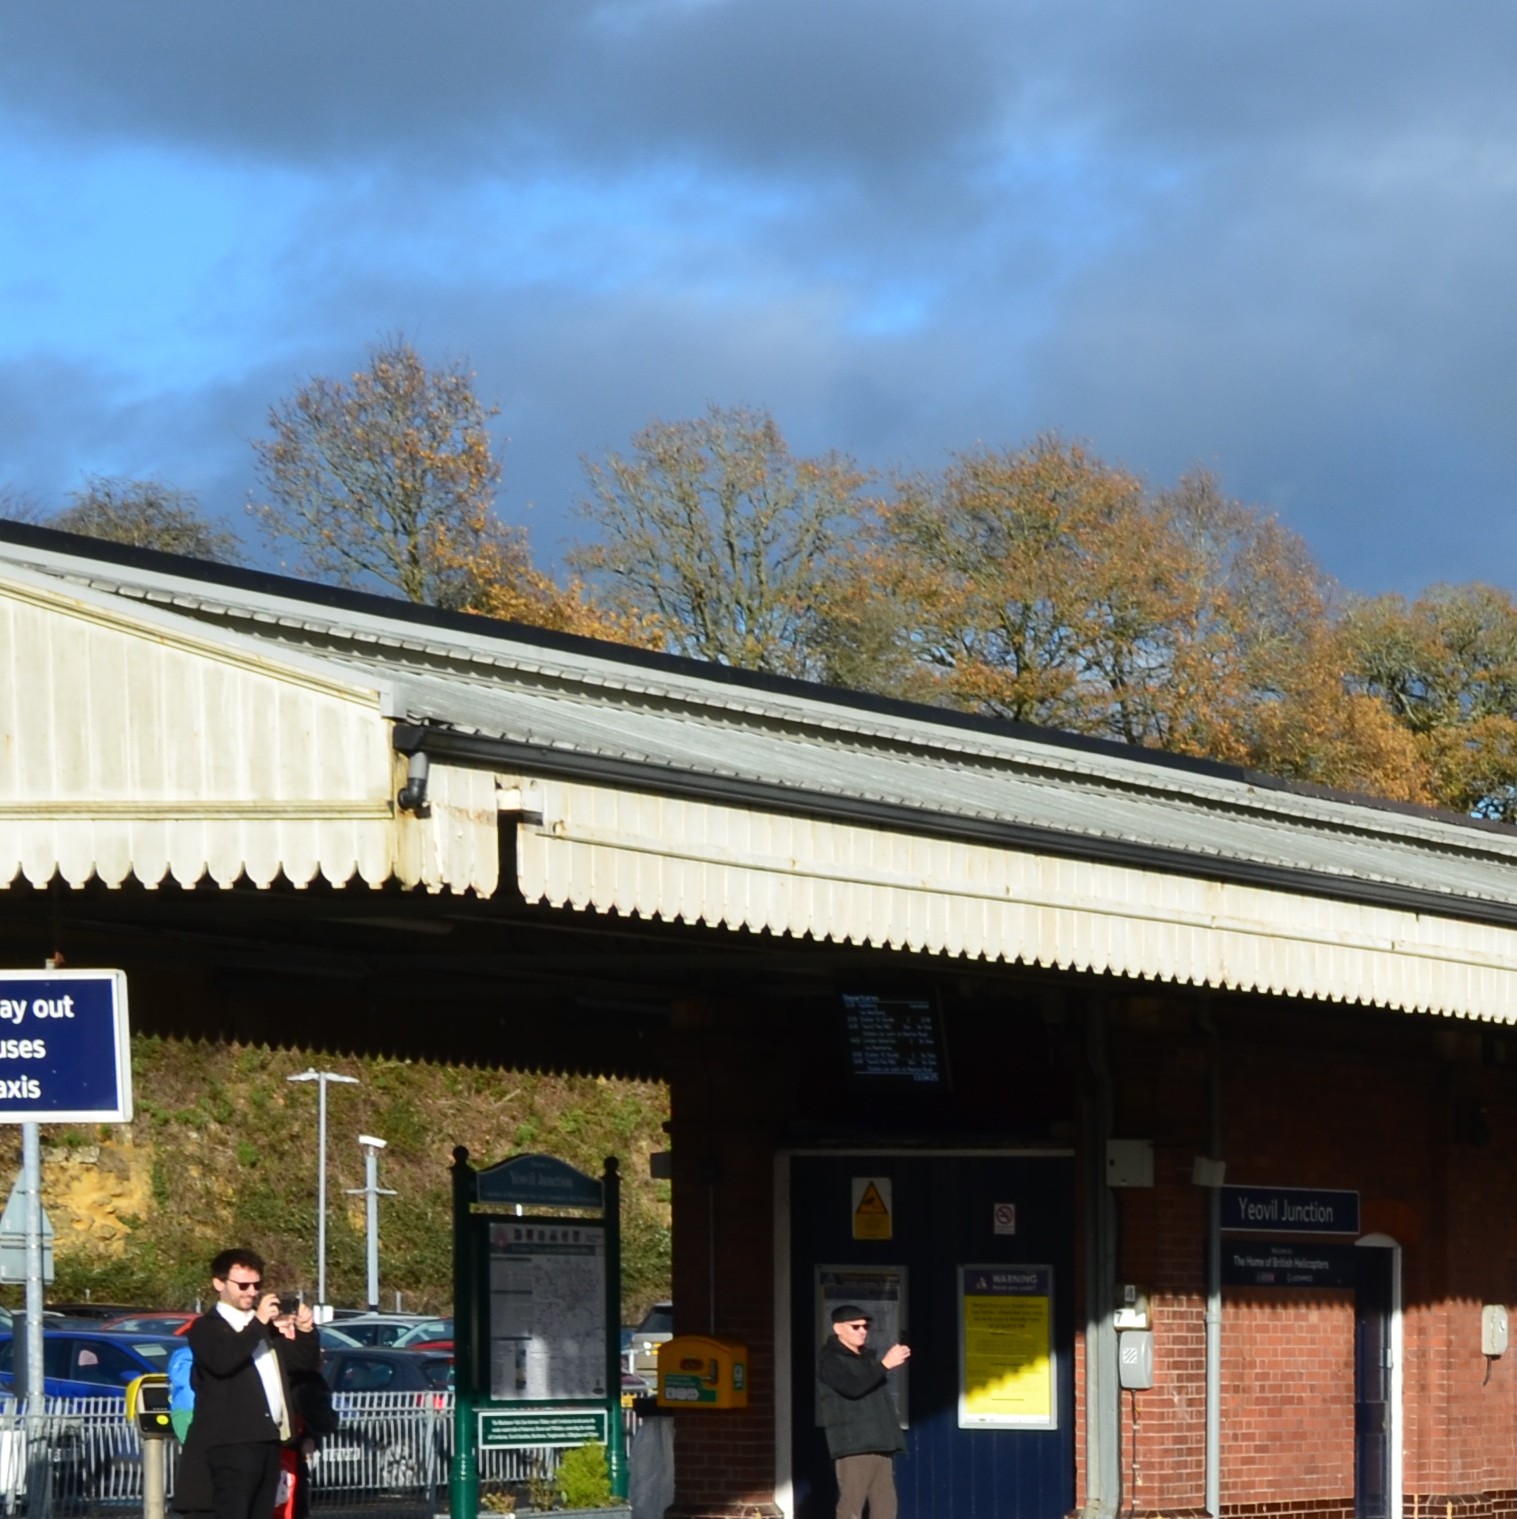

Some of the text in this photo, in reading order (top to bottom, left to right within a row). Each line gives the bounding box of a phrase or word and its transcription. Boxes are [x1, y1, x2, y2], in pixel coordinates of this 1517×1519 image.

[32, 994, 75, 1019] out
[1237, 1197, 1334, 1223] Yeovil Junction
[1233, 1255, 1329, 1271] The Home of British Helicopters
[992, 1274, 1038, 1284] WARNING
